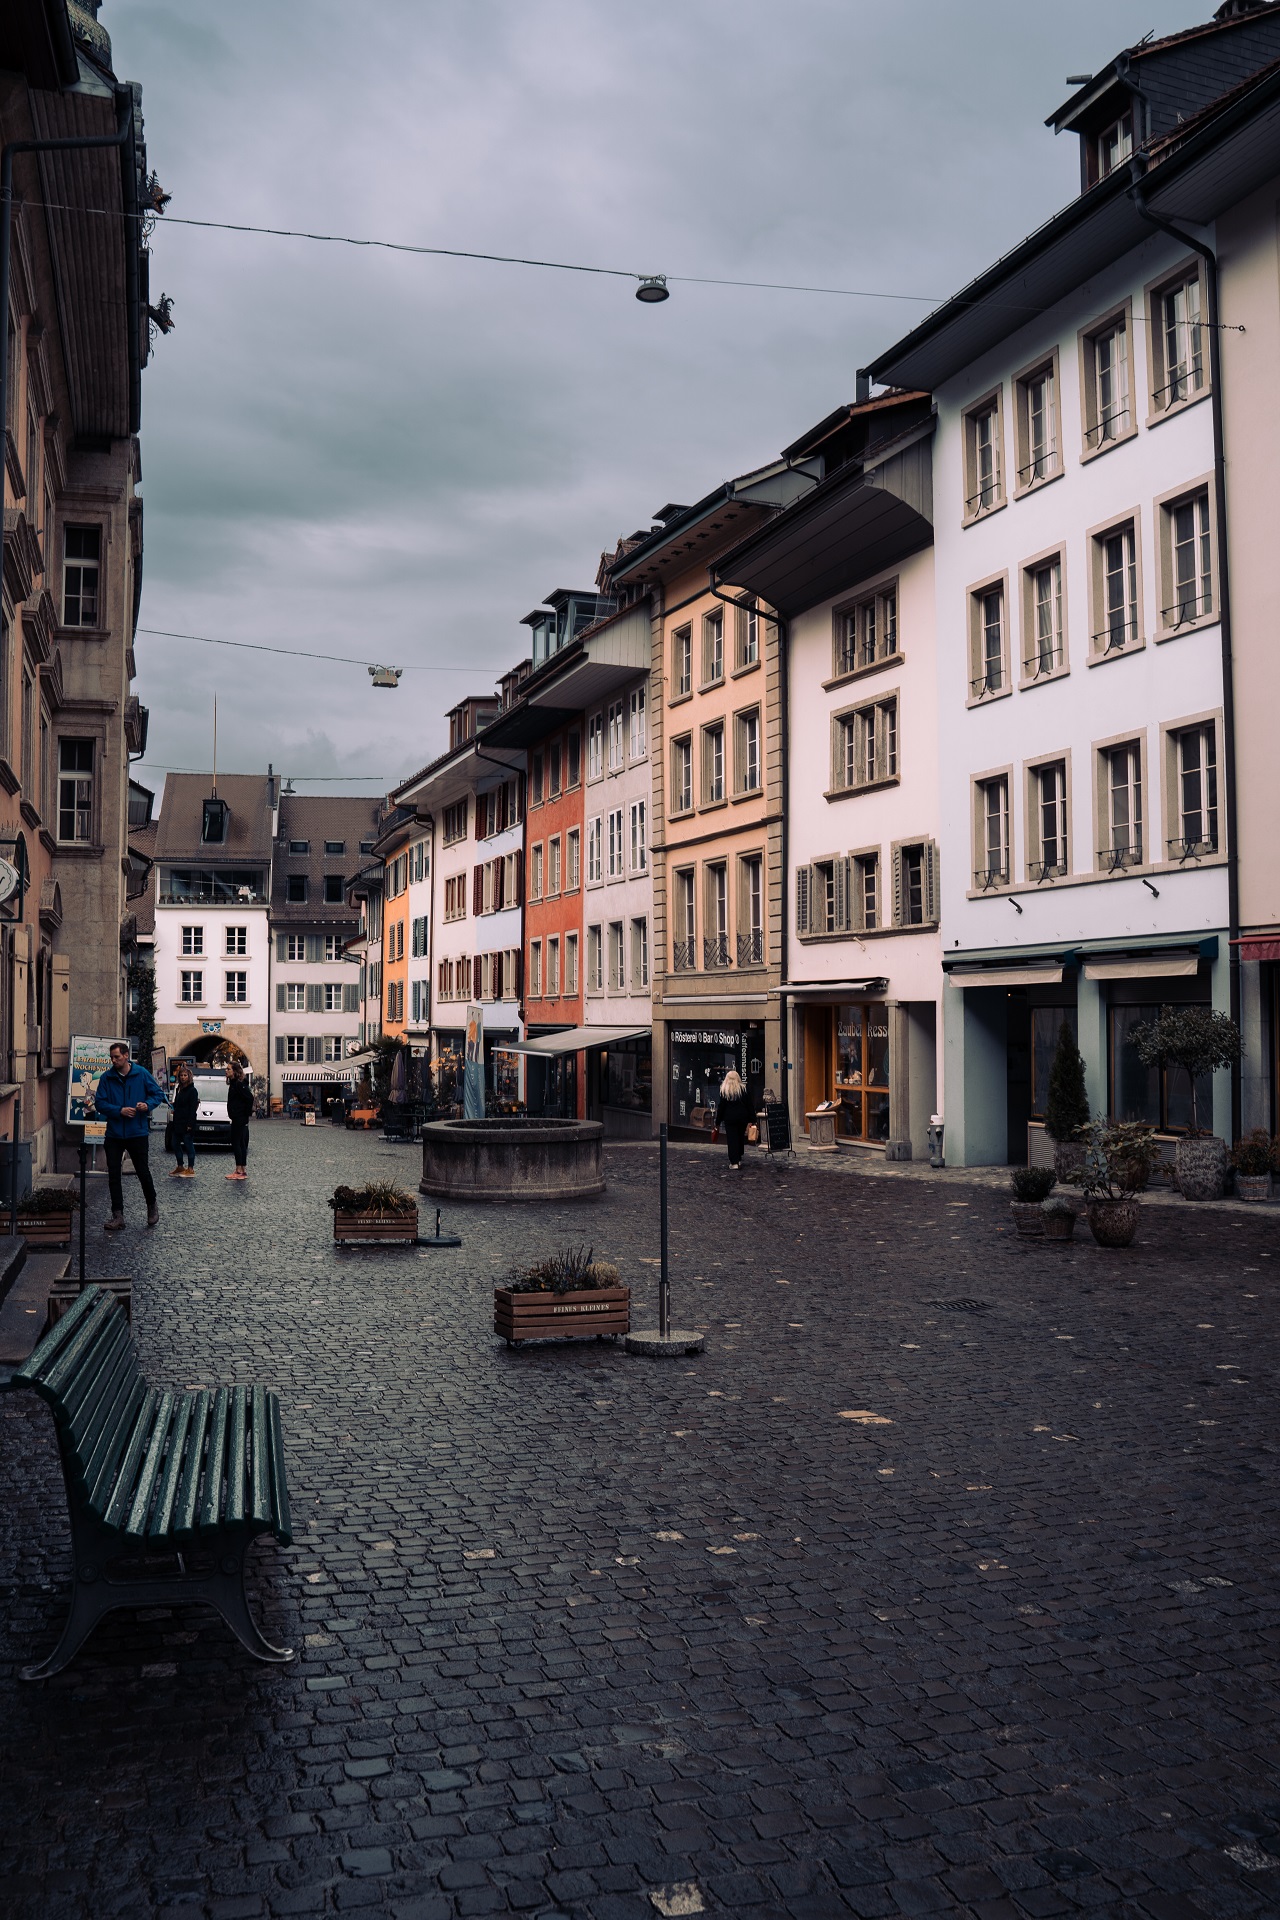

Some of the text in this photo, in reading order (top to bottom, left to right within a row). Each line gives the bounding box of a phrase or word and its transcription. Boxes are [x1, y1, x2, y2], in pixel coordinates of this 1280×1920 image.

[867, 1021, 889, 1038] kess
[675, 1031, 735, 1048] Rösterei Bar Shop
[580, 1304, 610, 1312] KLEINES
